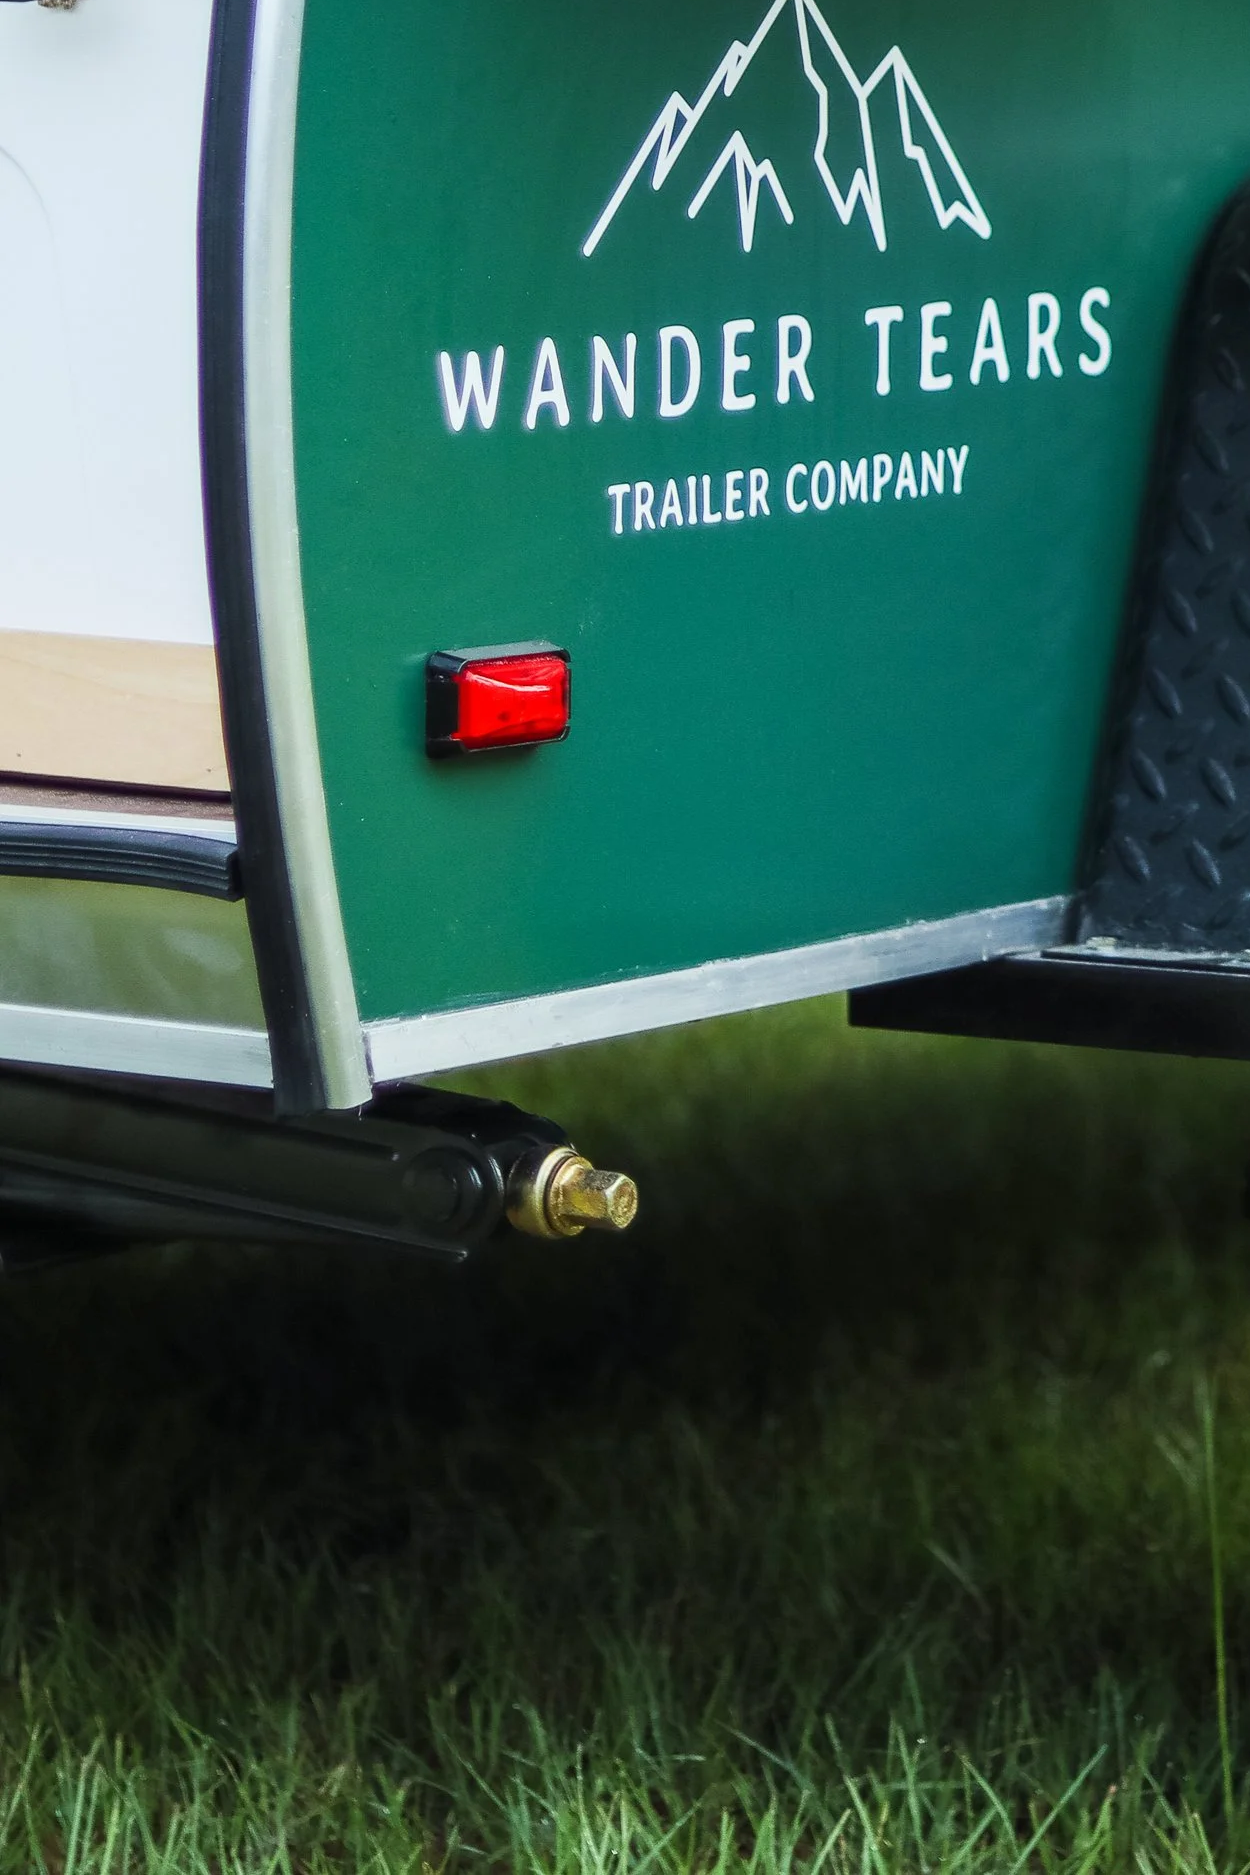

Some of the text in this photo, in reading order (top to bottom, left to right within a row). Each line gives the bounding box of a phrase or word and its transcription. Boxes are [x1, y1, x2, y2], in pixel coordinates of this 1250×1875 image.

[435, 286, 1112, 435] WANDER TEARS
[607, 444, 970, 535] TRAILER COMPANY
